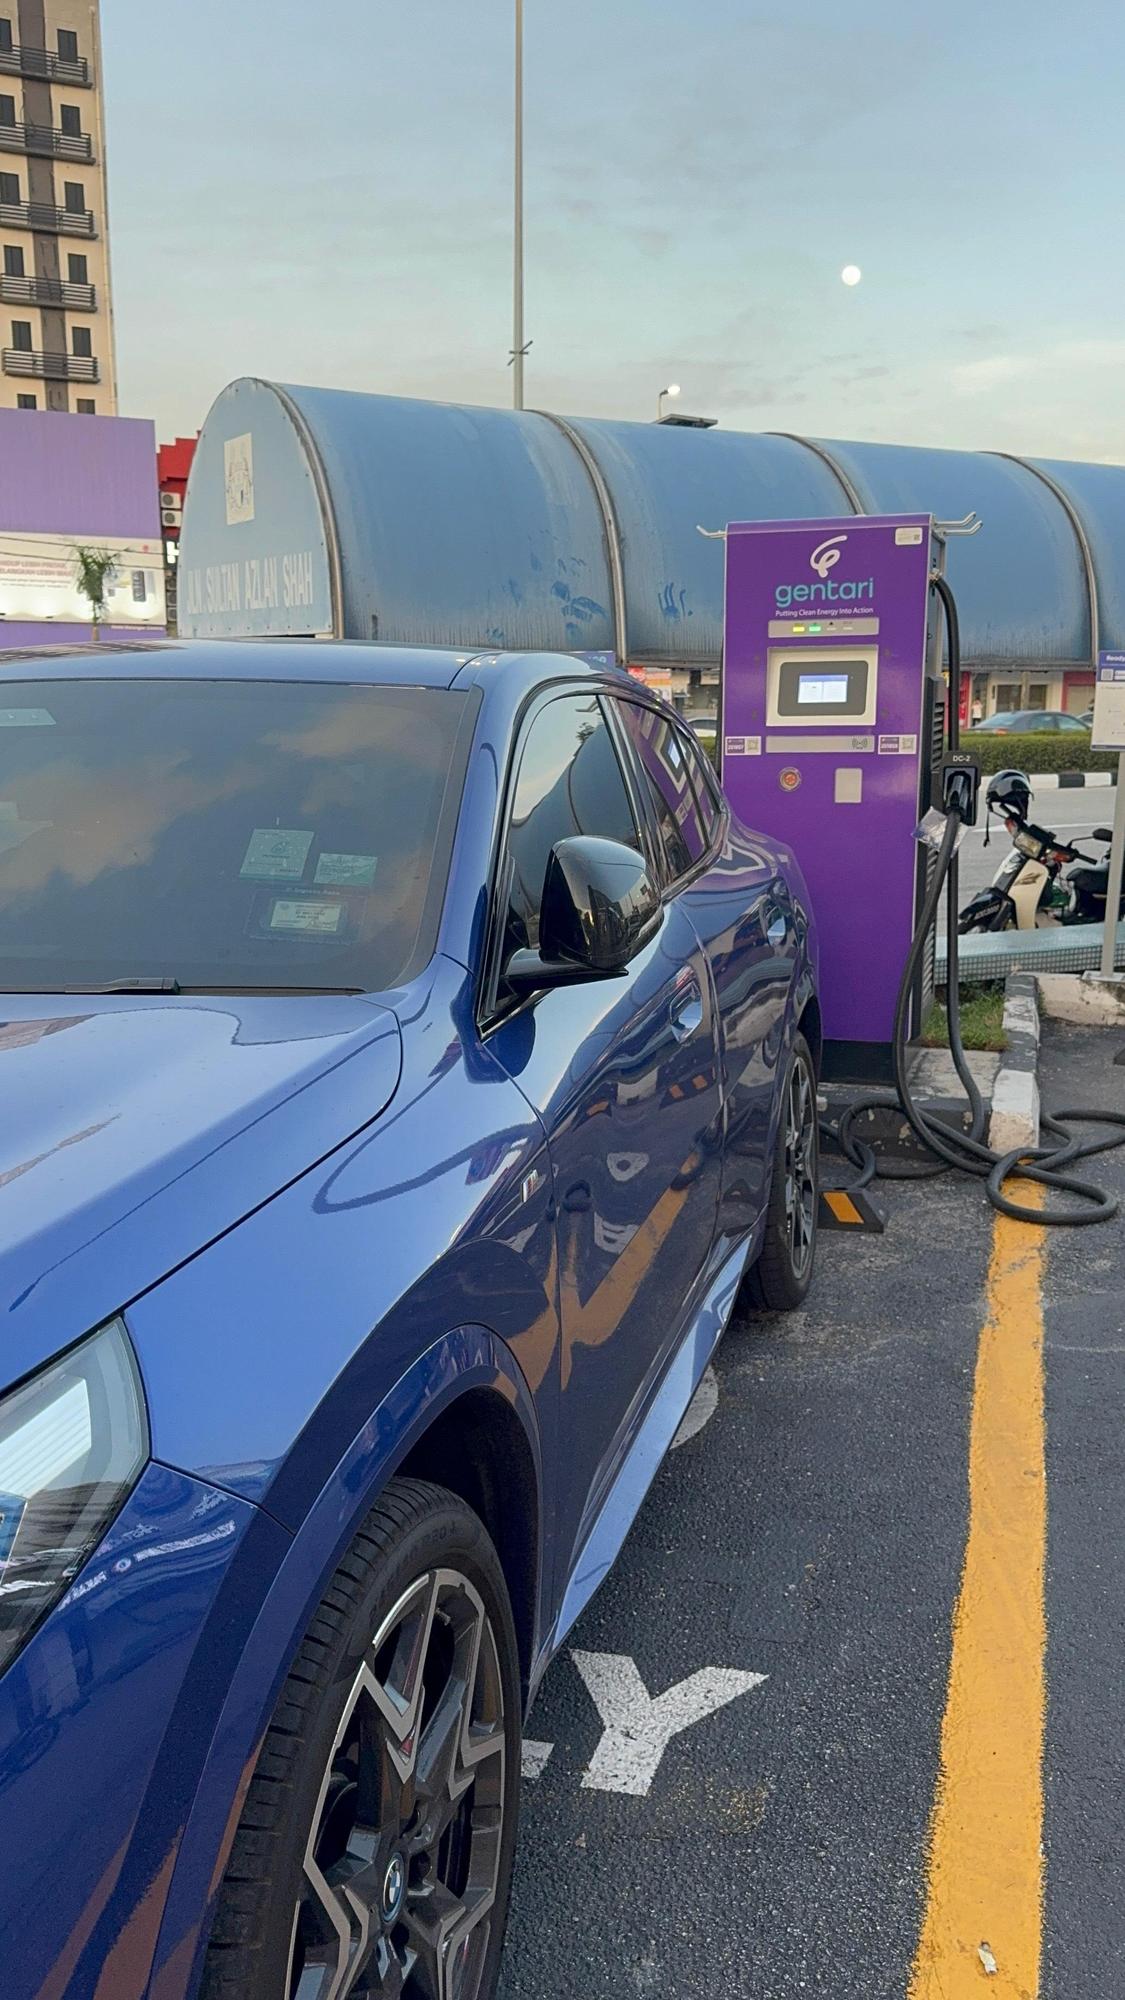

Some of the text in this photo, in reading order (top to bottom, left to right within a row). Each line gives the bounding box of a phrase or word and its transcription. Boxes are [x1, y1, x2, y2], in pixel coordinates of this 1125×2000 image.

[283, 551, 313, 608] SHAH
[775, 577, 874, 608] gentari
[775, 609, 798, 617] Putting
[798, 608, 816, 616] Clean
[817, 608, 838, 616] Energy
